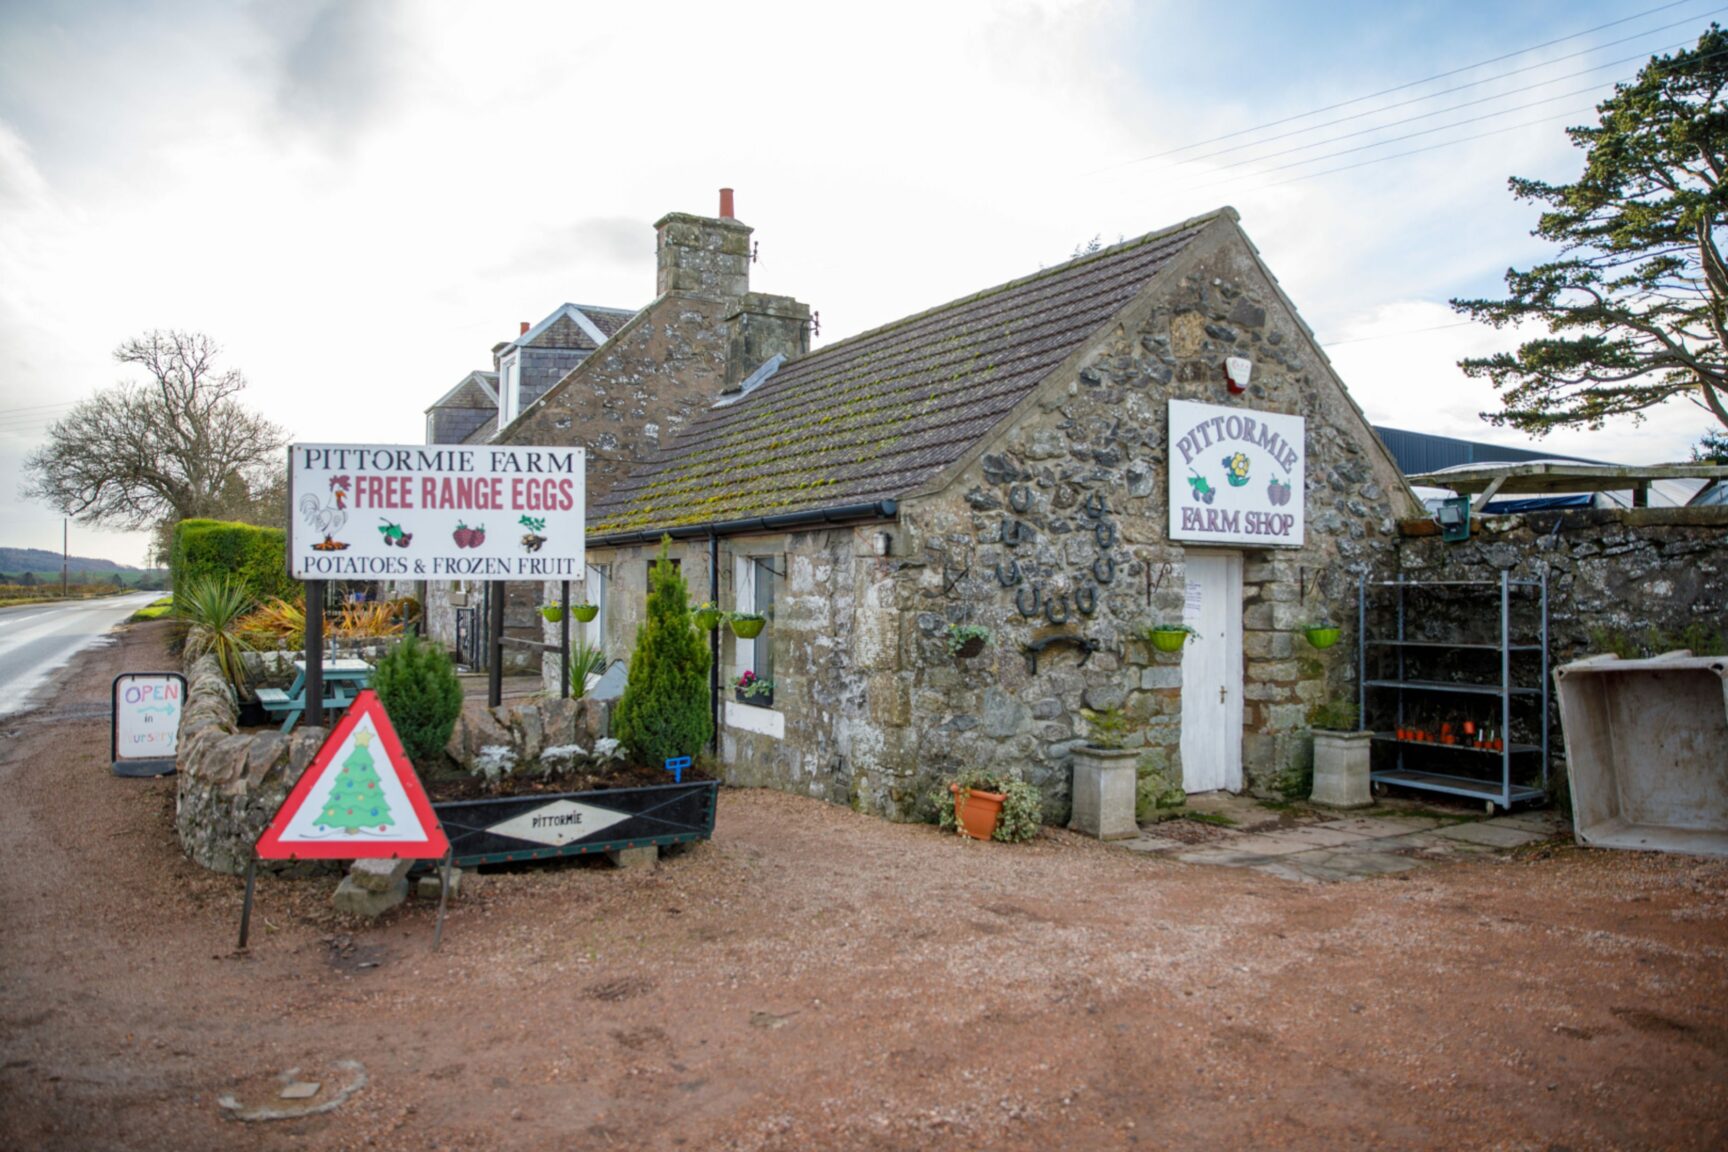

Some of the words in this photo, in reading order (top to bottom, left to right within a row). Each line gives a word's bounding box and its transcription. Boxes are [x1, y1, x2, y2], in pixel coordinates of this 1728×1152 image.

[1176, 415, 1298, 474] PITTORMIE
[304, 449, 474, 472] PITTORMIE
[491, 451, 574, 473] FARM
[355, 475, 414, 509] FREE
[422, 476, 503, 510] RANGE
[511, 478, 574, 511] EGGS
[1181, 507, 1240, 533] FARM
[1244, 511, 1295, 536] SHOP
[304, 556, 408, 575] POTATOES
[414, 559, 426, 574] &
[433, 557, 512, 575] FROZEN
[518, 558, 575, 576] FRUIT
[125, 684, 178, 704] OPEN
